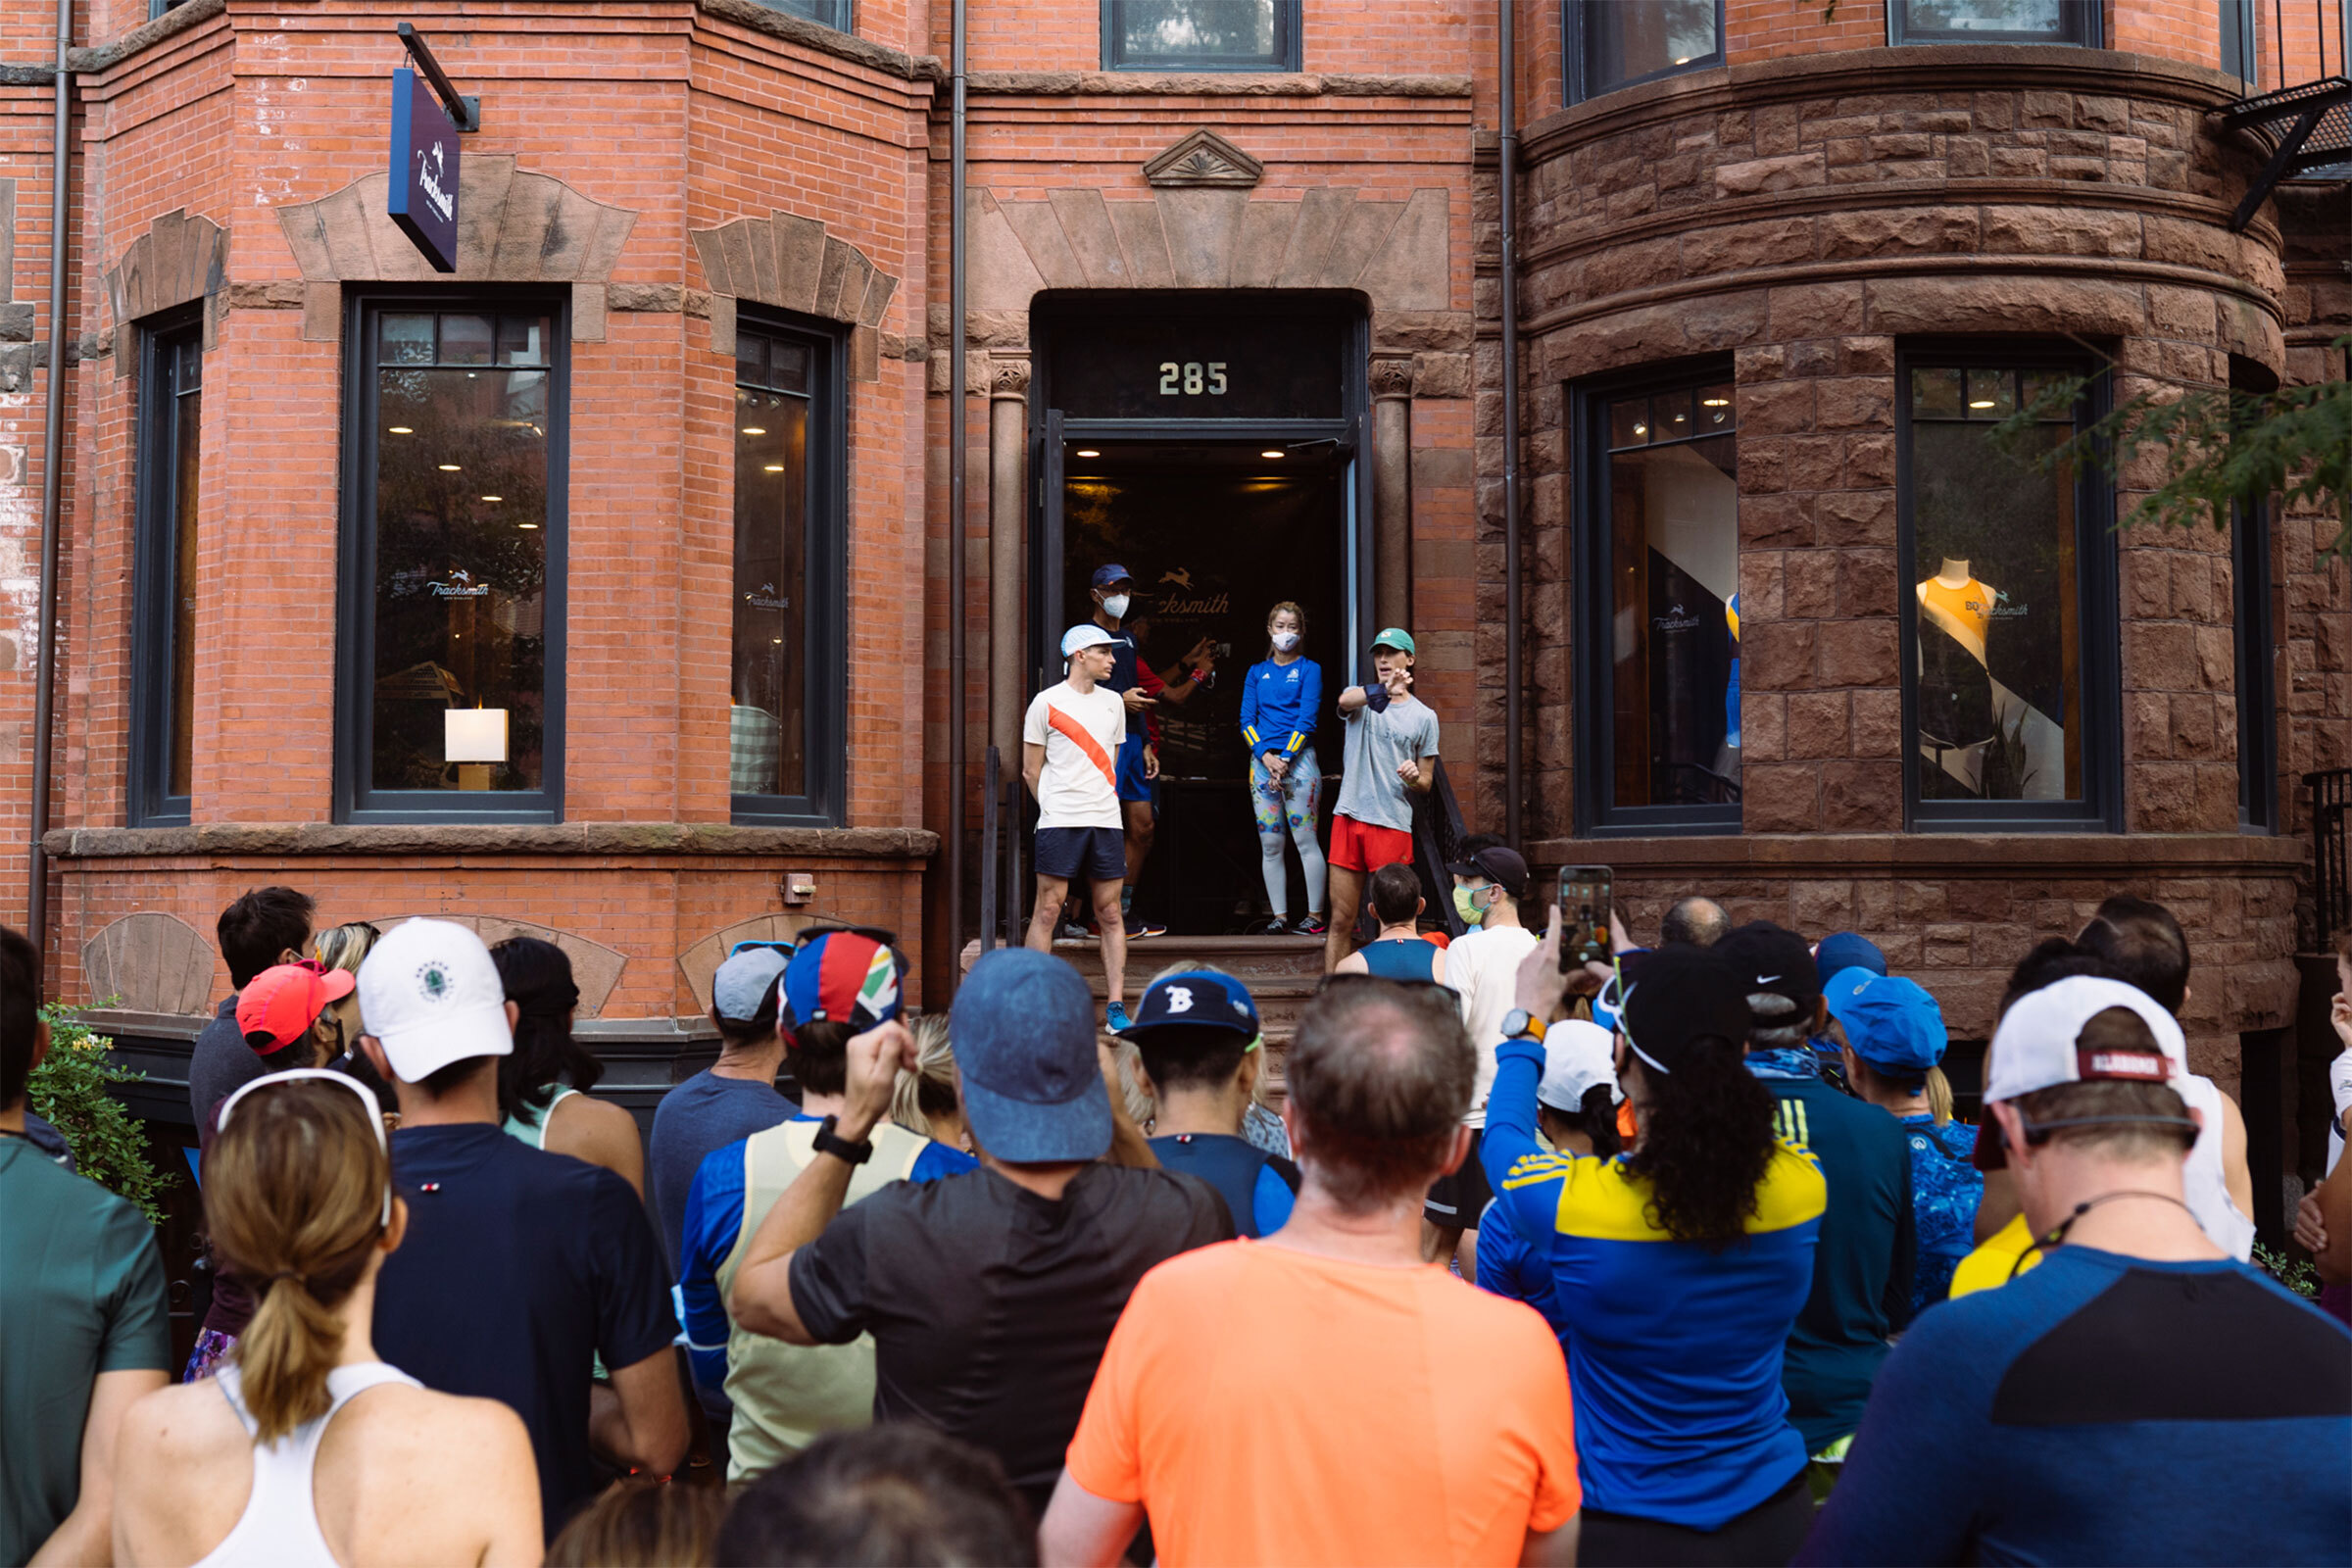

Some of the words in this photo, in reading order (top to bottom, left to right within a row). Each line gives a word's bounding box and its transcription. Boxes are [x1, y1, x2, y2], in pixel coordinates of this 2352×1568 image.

[1159, 362, 1227, 395] 285
[426, 581, 489, 597] Tracksmith
[744, 592, 789, 609] Tracksmith
[1164, 985, 1194, 1013] B
